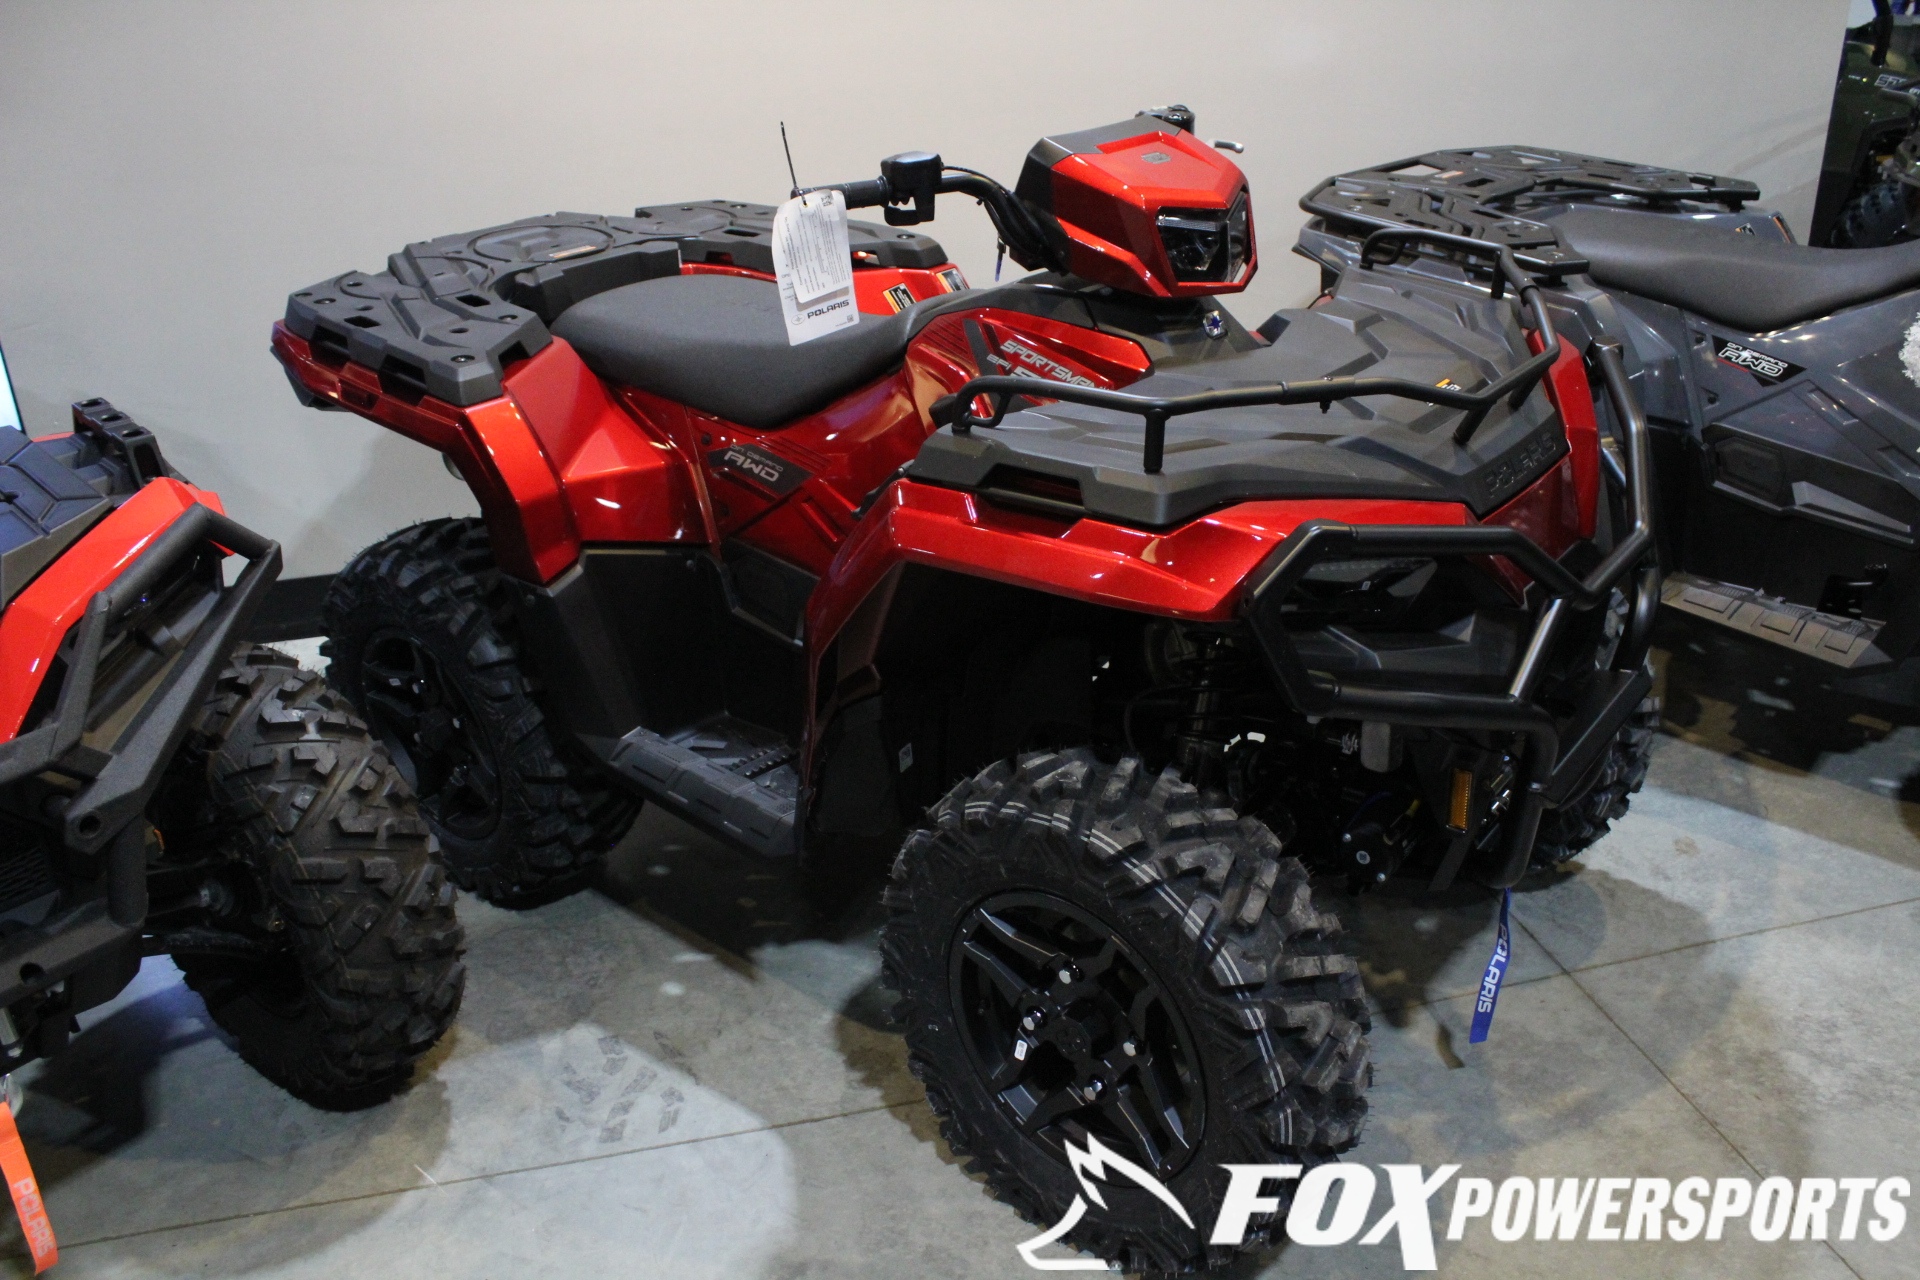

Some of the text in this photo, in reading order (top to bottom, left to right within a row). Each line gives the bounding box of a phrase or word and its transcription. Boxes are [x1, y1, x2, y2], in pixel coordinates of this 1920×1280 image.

[807, 300, 850, 319] POLARIS
[986, 353, 1012, 371] EFI
[1718, 347, 1783, 377] AWD
[723, 450, 780, 482] AWD
[1477, 923, 1509, 1013] POLARIS
[13, 1176, 55, 1257] POLARIS
